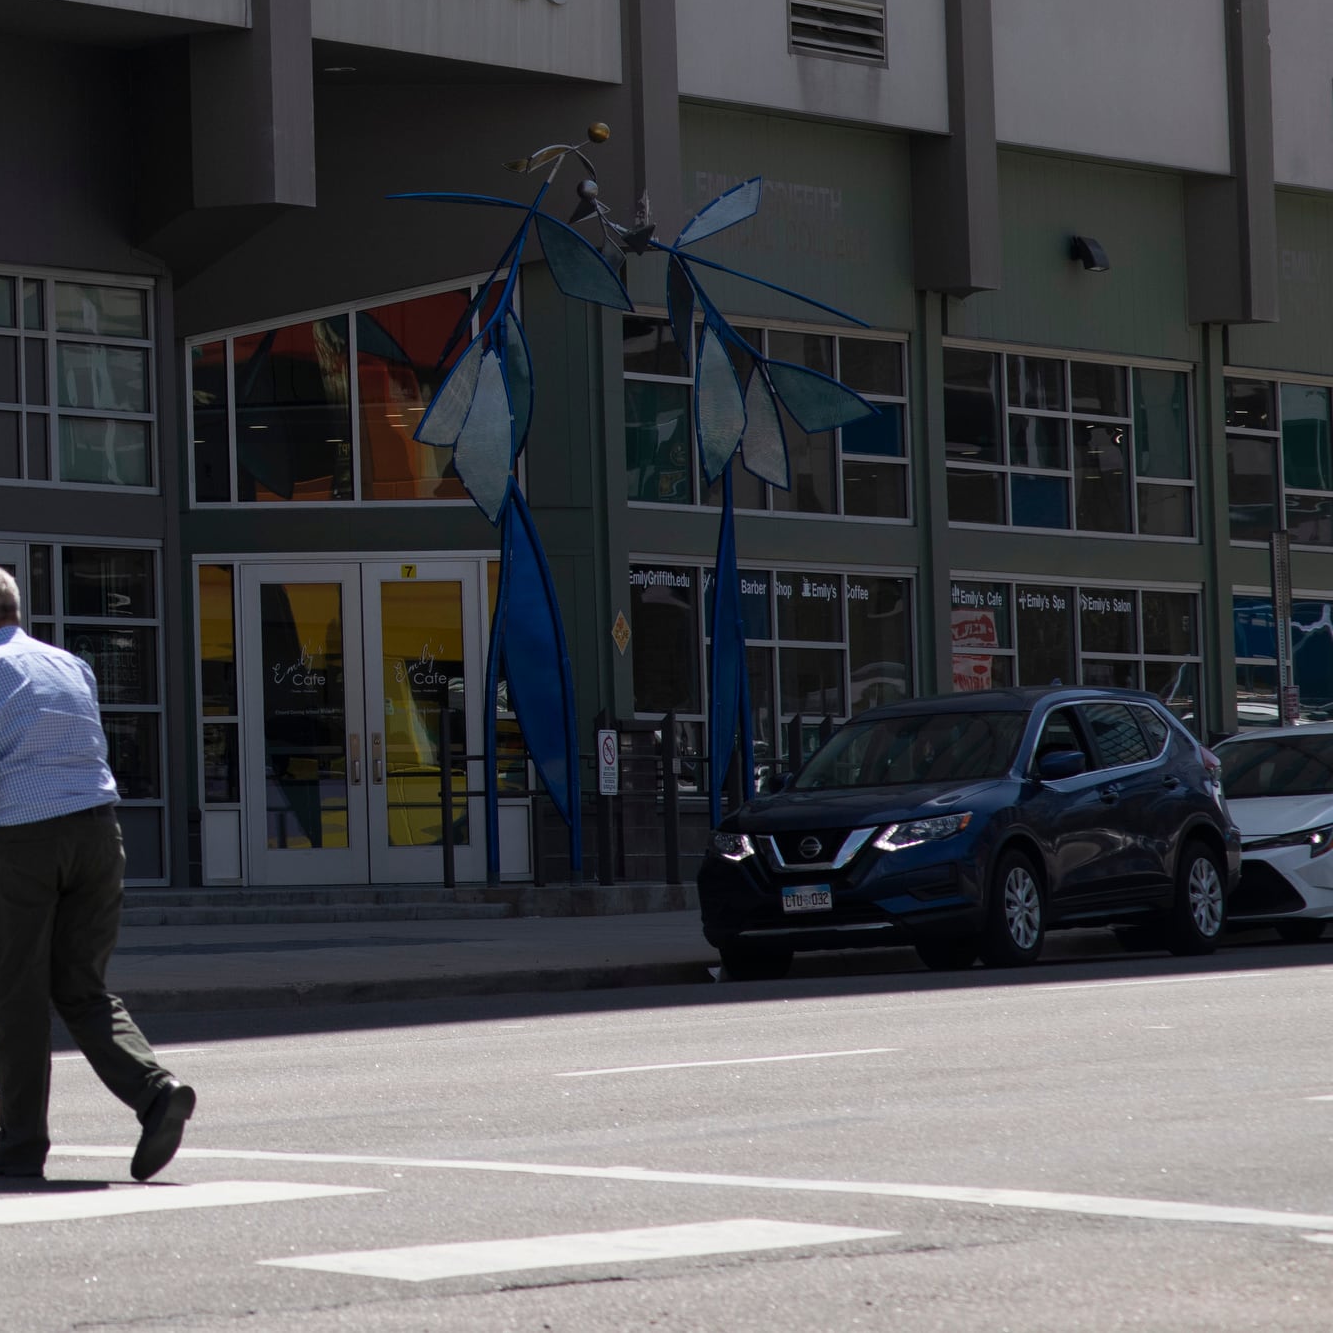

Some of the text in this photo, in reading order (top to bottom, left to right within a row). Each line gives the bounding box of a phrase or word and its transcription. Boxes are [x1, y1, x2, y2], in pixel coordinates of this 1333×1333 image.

[404, 565, 414, 578] 7
[741, 579, 792, 599] Barber Shop
[813, 582, 869, 602] Emily's Coffee
[961, 590, 1002, 609] Emily's Cafe
[1027, 594, 1065, 612] Emily's Spa
[1088, 596, 1131, 615] Emily's Salon
[292, 673, 326, 686] Cafe
[413, 672, 447, 685] Cafe
